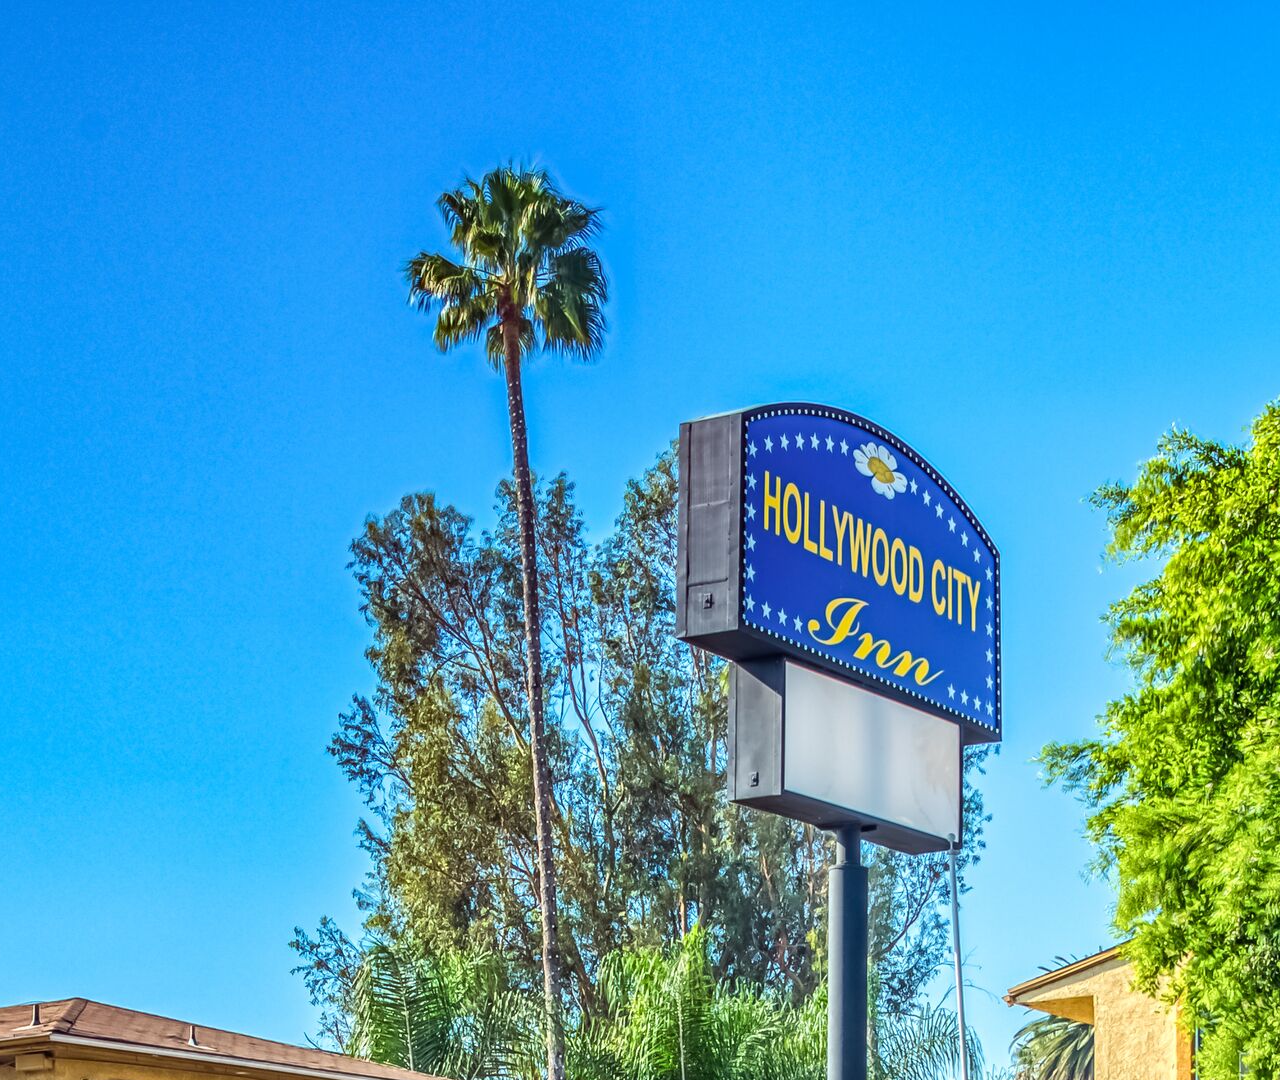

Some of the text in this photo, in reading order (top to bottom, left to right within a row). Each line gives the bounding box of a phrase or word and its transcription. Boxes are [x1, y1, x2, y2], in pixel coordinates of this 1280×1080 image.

[764, 470, 980, 632] HOLLYWOOD CITY
[808, 597, 944, 686] Inn
